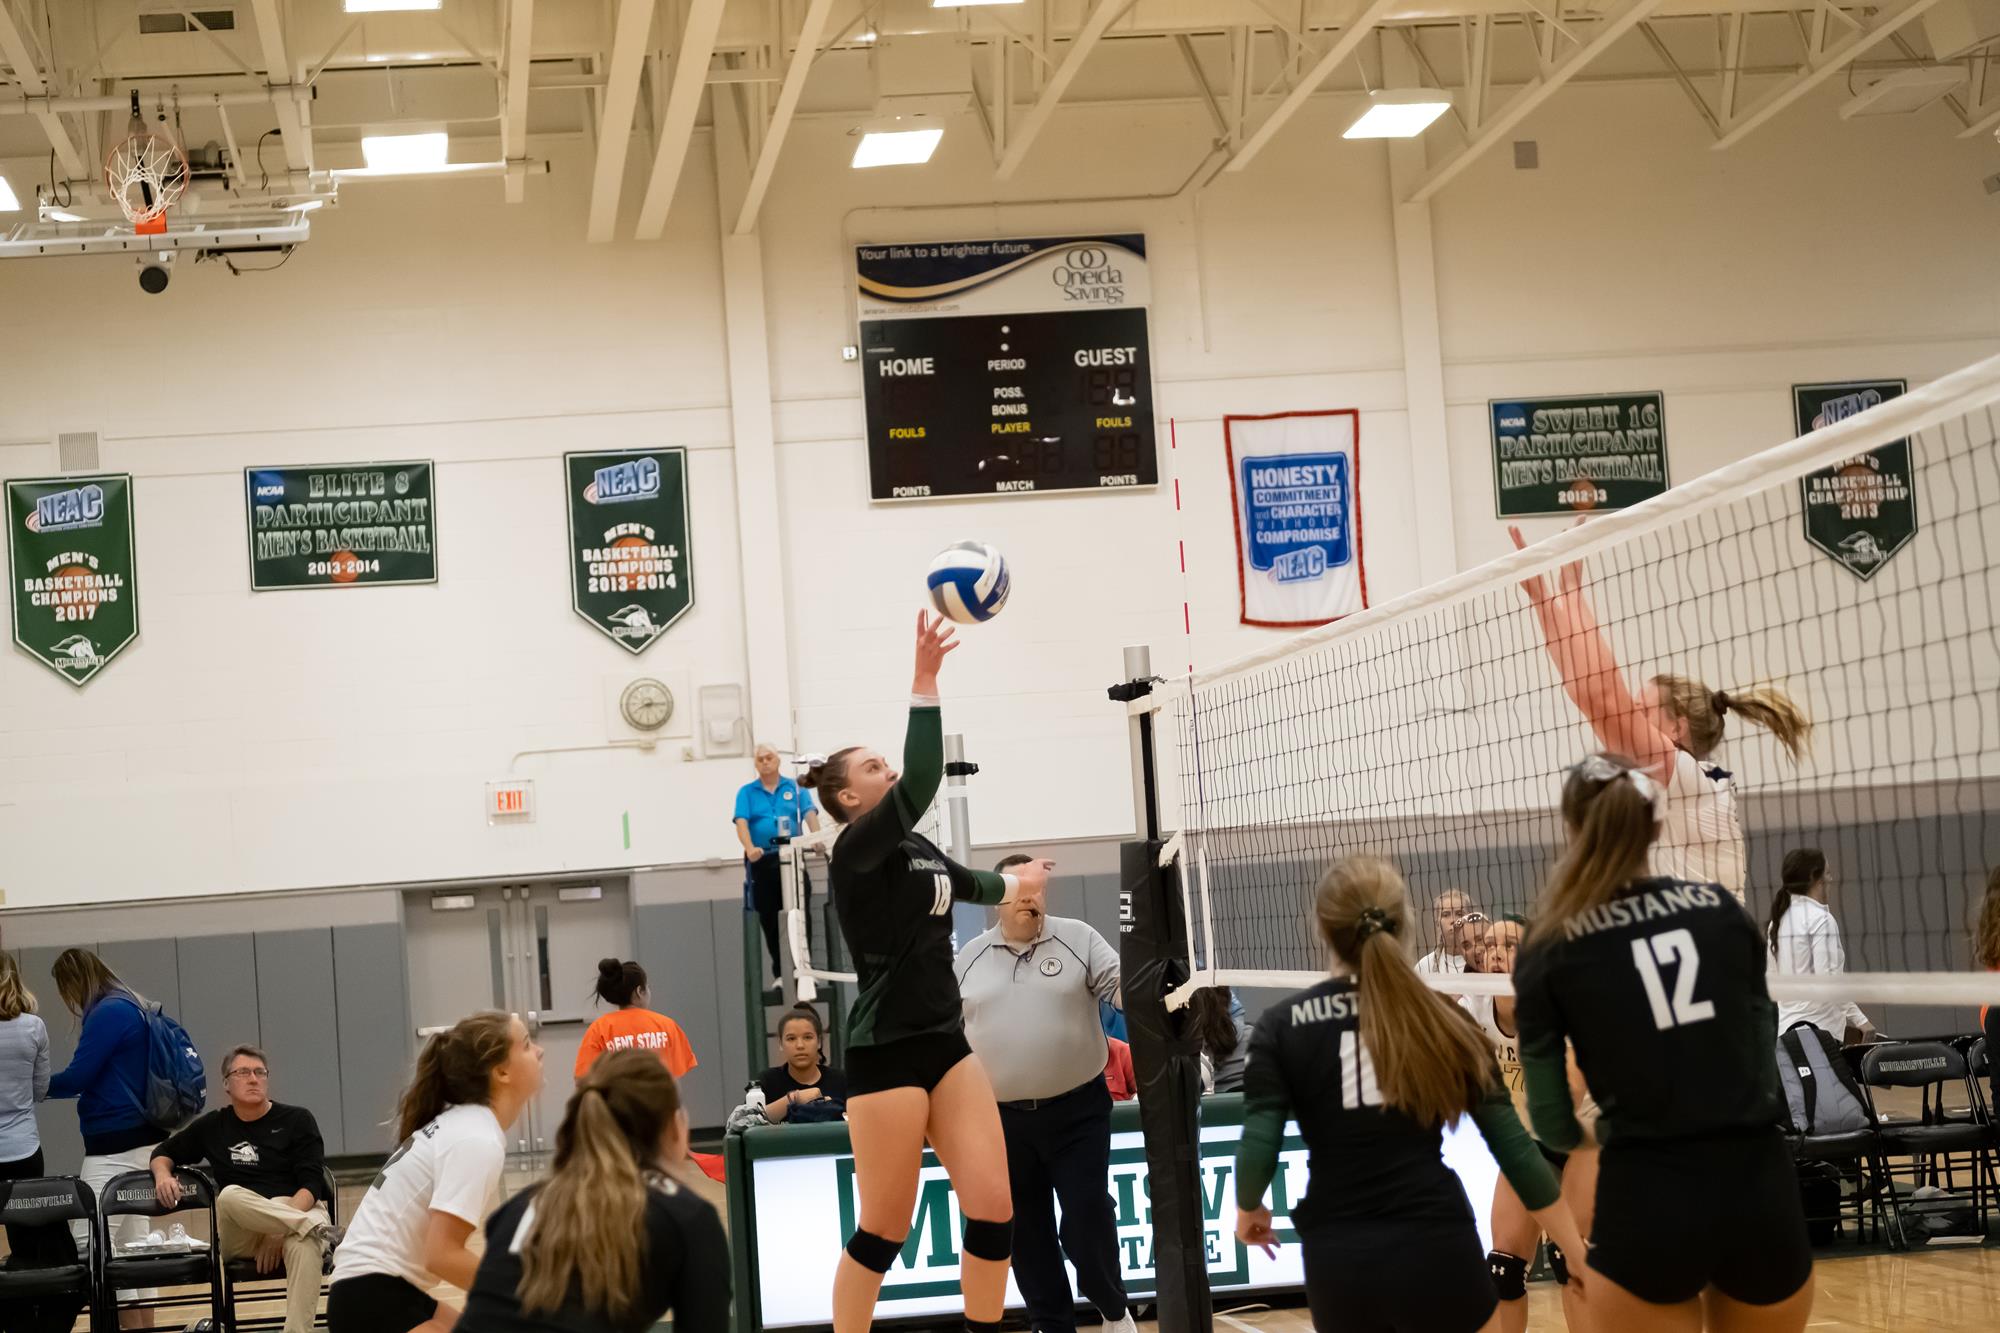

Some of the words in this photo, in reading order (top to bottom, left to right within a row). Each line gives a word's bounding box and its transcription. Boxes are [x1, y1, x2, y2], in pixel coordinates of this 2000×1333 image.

[859, 248, 887, 261] Your
[890, 247, 911, 259] link
[915, 247, 928, 258] to
[930, 249, 938, 258] a
[941, 244, 989, 258] brighter
[992, 242, 1033, 254] future.
[1053, 265, 1122, 287] Oneida
[1064, 284, 1124, 304] Savings
[987, 358, 1026, 372] PERIOD
[1074, 347, 1136, 367] GUEST
[879, 357, 935, 376] HOME
[993, 387, 1024, 399] POSS.
[991, 403, 1028, 416] BONUS
[1532, 404, 1620, 433] SWEET
[1628, 403, 1658, 429] 16
[991, 421, 1031, 434] PLAYER
[1096, 416, 1132, 428] FOULS
[889, 427, 926, 439] FOULS
[1499, 428, 1659, 458] PARTICIPANT
[596, 458, 658, 498] NEAC
[1100, 474, 1137, 486] POINTS
[1501, 459, 1552, 490] MEN'S
[1555, 454, 1663, 483] BASKETBALL
[256, 485, 285, 497] NCAA
[308, 472, 385, 498] ELITE
[394, 471, 410, 495] 8
[892, 485, 931, 497] POINTS
[996, 480, 1034, 492] MATCH
[1812, 473, 1902, 491] BASKETBALL
[1256, 487, 1338, 504] COMMITMENT
[1808, 487, 1909, 505] CHAMPIONSHIP
[39, 485, 102, 527] NEAC
[255, 498, 428, 529] PARTICIPANT
[1271, 503, 1341, 519] CHARACTER
[1841, 503, 1879, 520] 2013
[603, 522, 656, 544] MEN'S
[1256, 527, 1340, 544] COMPROMISE
[257, 529, 312, 561] MEN'S
[315, 524, 431, 555] BASKETBALL
[46, 551, 99, 573] MEN'S
[582, 545, 679, 562] BASKETBALL
[308, 559, 380, 576] 2013-2014
[589, 559, 674, 577] CHAMPIONS
[1277, 548, 1325, 581] NEAC
[24, 574, 123, 593] BASKETBALL
[588, 574, 677, 593] 2013-2014
[31, 588, 118, 606] CHAMPIONS
[55, 605, 96, 622] 2017
[497, 790, 523, 811] EXIT
[1562, 885, 1721, 942] MUSTANGS
[1630, 928, 1716, 1031] 12
[1291, 991, 1360, 1027] MUST
[636, 1031, 668, 1049] STAFF
[1878, 1056, 1948, 1073] MORRISVILLE
